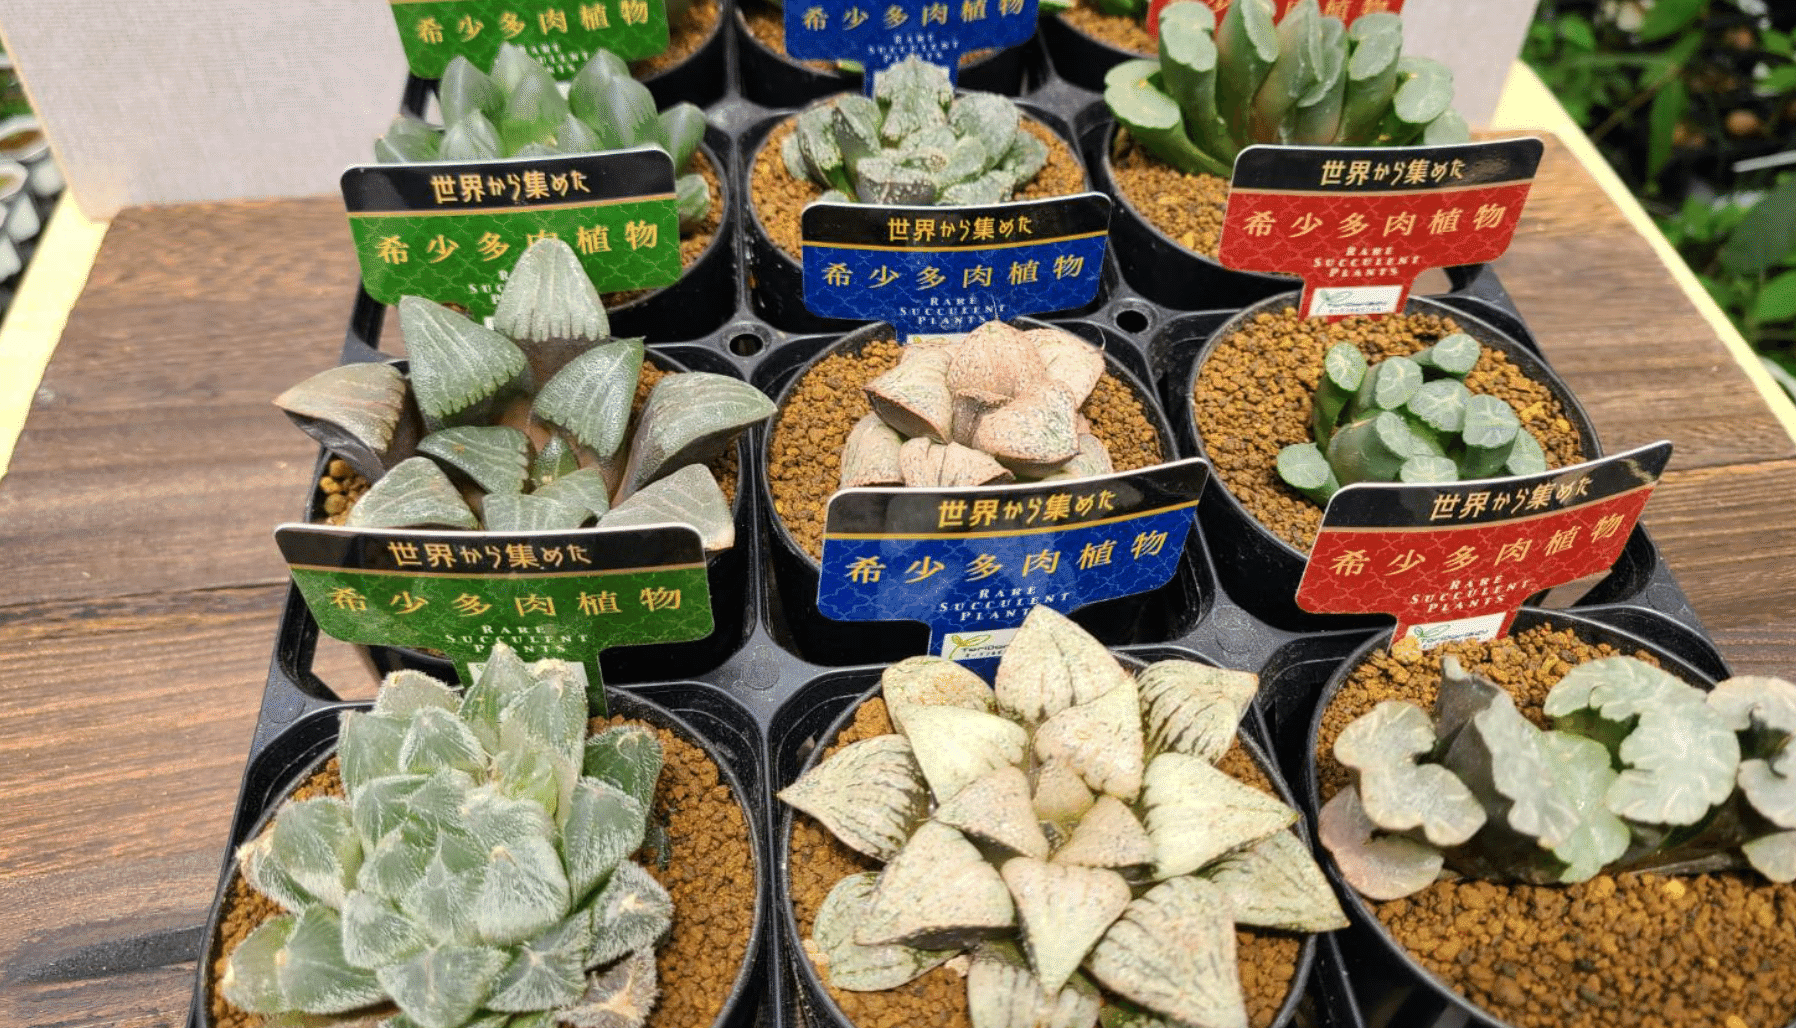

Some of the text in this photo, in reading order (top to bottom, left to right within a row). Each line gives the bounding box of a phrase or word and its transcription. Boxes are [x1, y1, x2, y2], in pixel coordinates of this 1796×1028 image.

[1319, 158, 1466, 186] 世界から集めた
[430, 169, 591, 204] 世界から集めた
[888, 215, 1033, 242] 世界から集めた
[1243, 203, 1507, 239] 希少多肉植物
[821, 254, 1085, 291] 希少多肉植物
[900, 304, 1005, 316] SUCCULENT
[930, 296, 977, 306] RARE
[937, 490, 1118, 529] 世界から集めた
[1429, 476, 1593, 521] 世界から集めた
[387, 541, 593, 570] 世界から集めた
[845, 530, 1168, 585] 希少多肉植物
[1328, 513, 1625, 577] 希少多肉植物
[979, 586, 1036, 600] RARE
[1410, 579, 1530, 605] SUCCULENT
[1450, 574, 1503, 590] RARE
[328, 586, 682, 618] 希少多肉植物
[940, 592, 1070, 612] SUCCULENT
[960, 608, 1030, 621] PLANT
[1427, 594, 1506, 613] PLANTS
[482, 624, 547, 634] RARE
[474, 644, 566, 653] PANTS
